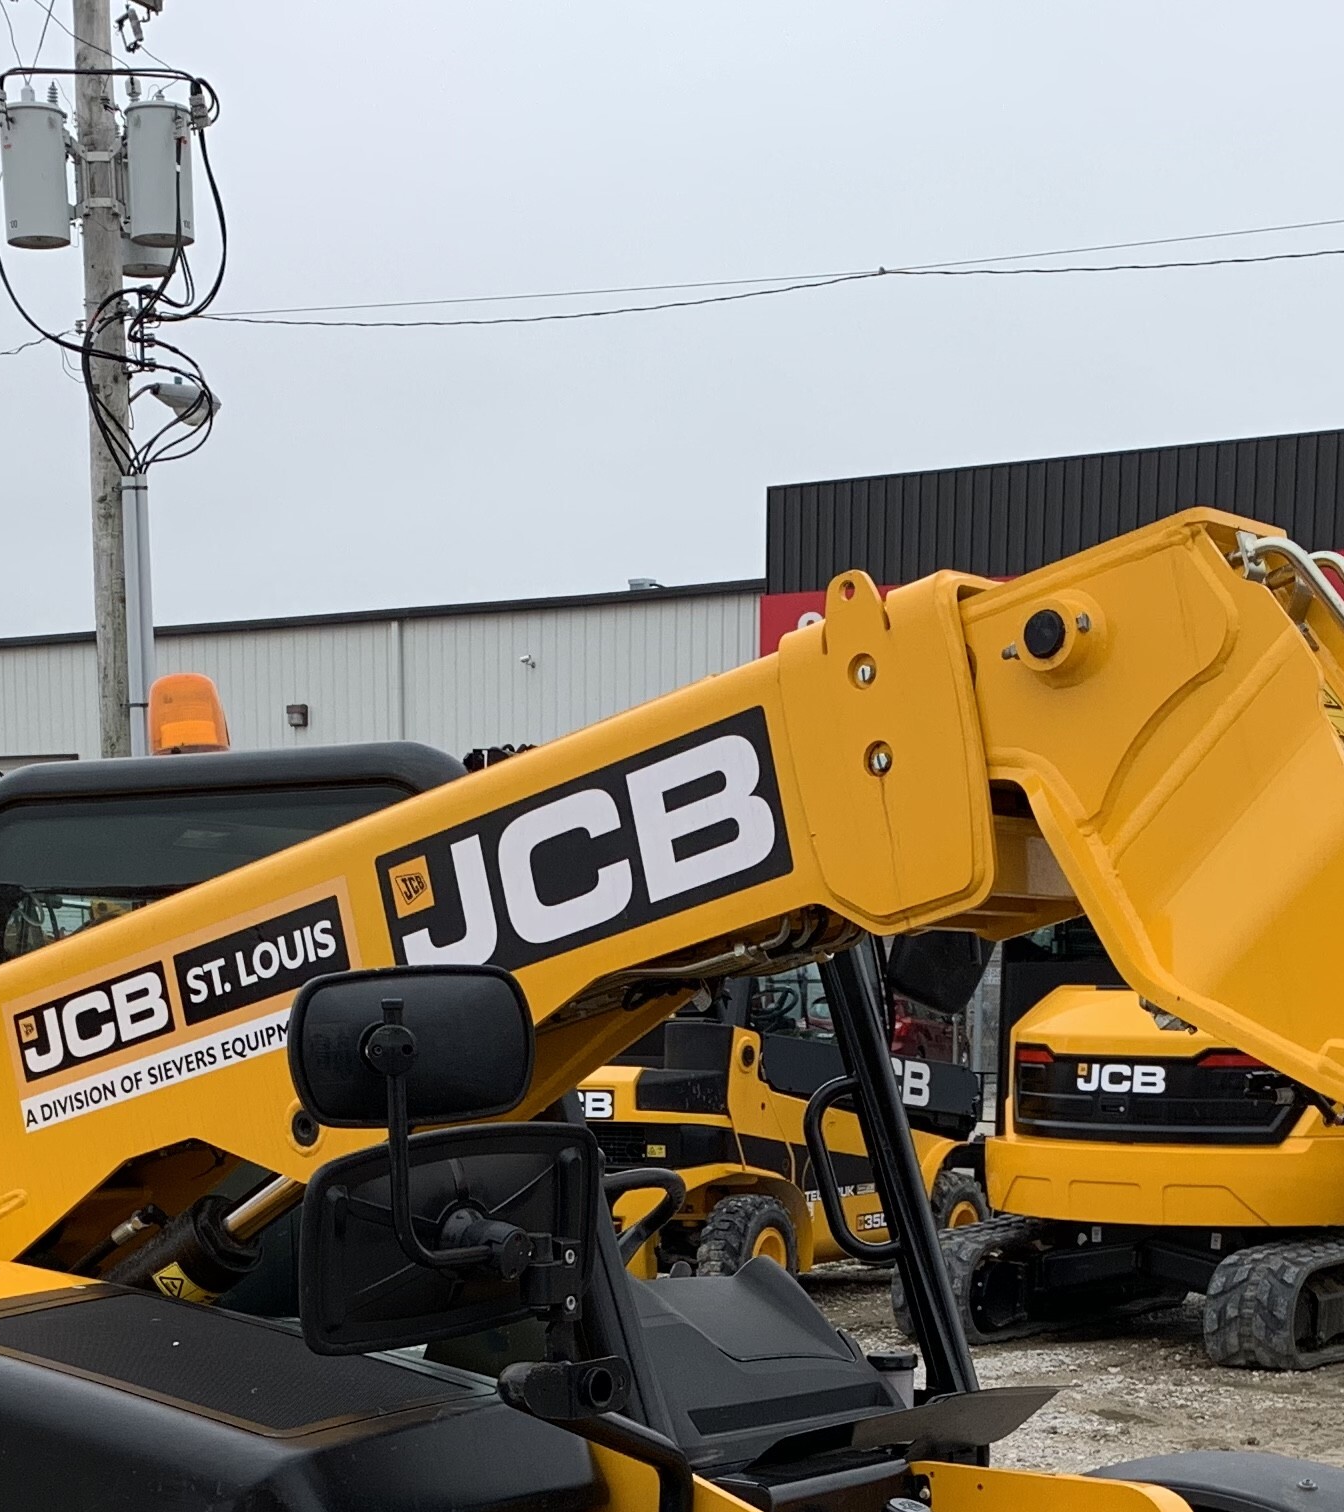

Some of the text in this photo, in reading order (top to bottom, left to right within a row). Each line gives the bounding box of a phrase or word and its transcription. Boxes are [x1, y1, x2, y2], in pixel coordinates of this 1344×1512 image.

[401, 875, 425, 900] JCB
[402, 734, 776, 966] JCB
[24, 919, 337, 1073] JCB ST. LOUIS
[26, 1108, 38, 1128] A
[41, 1080, 117, 1122] DIVISION
[120, 1071, 144, 1094] OF
[147, 1044, 217, 1085] SIEVERS
[1077, 1063, 1166, 1094] JCB
